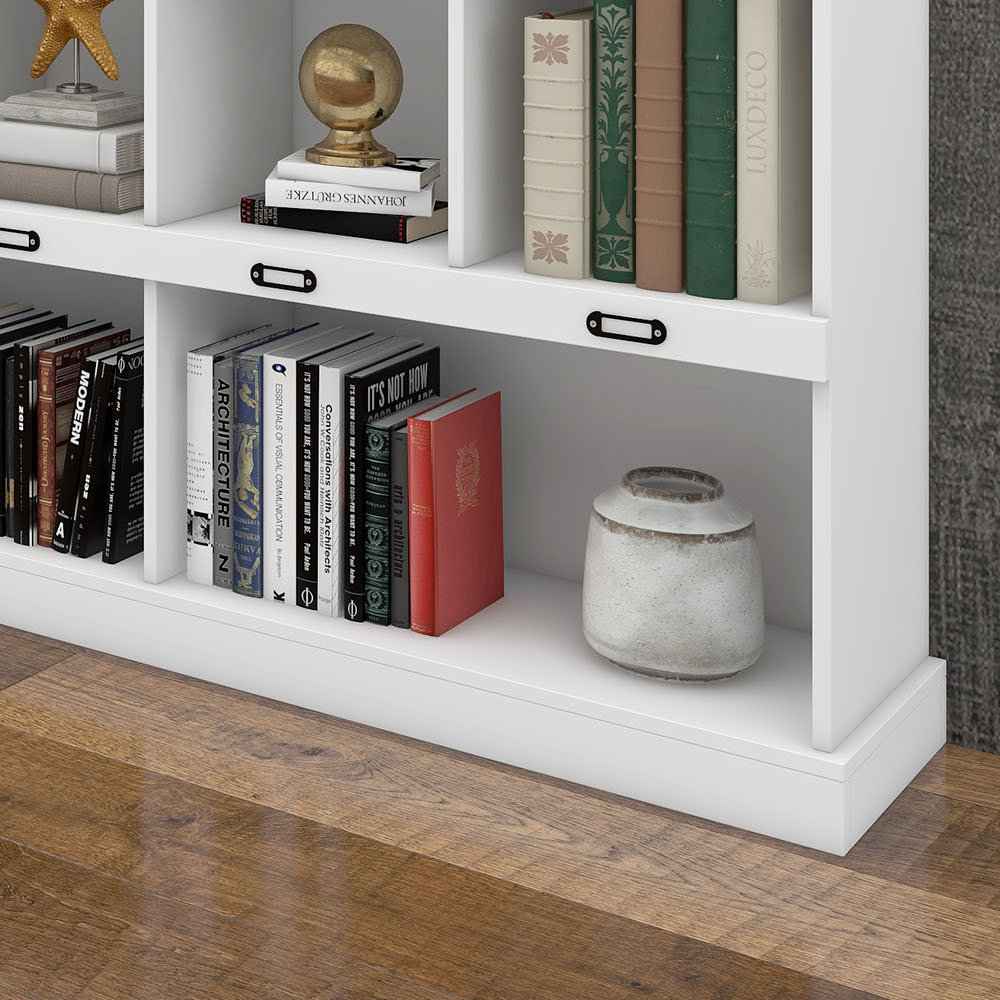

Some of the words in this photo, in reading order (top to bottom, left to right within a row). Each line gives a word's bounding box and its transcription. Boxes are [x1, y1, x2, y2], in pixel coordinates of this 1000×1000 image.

[745, 51, 768, 175] LUXDECO
[286, 189, 342, 204] GRÜTZKE
[343, 193, 407, 208] JOHANNES
[70, 370, 91, 446] MODERN
[275, 383, 283, 430] ESSENTIALS
[367, 380, 385, 413] IT'S
[387, 371, 406, 404] NOT
[408, 362, 429, 395] HOW
[217, 378, 230, 528] ARCHITECTURE
[275, 432, 283, 443] OF
[275, 445, 283, 473] VISUAL
[325, 404, 333, 486] Conversations
[325, 489, 333, 513] with
[325, 516, 333, 574] Architects
